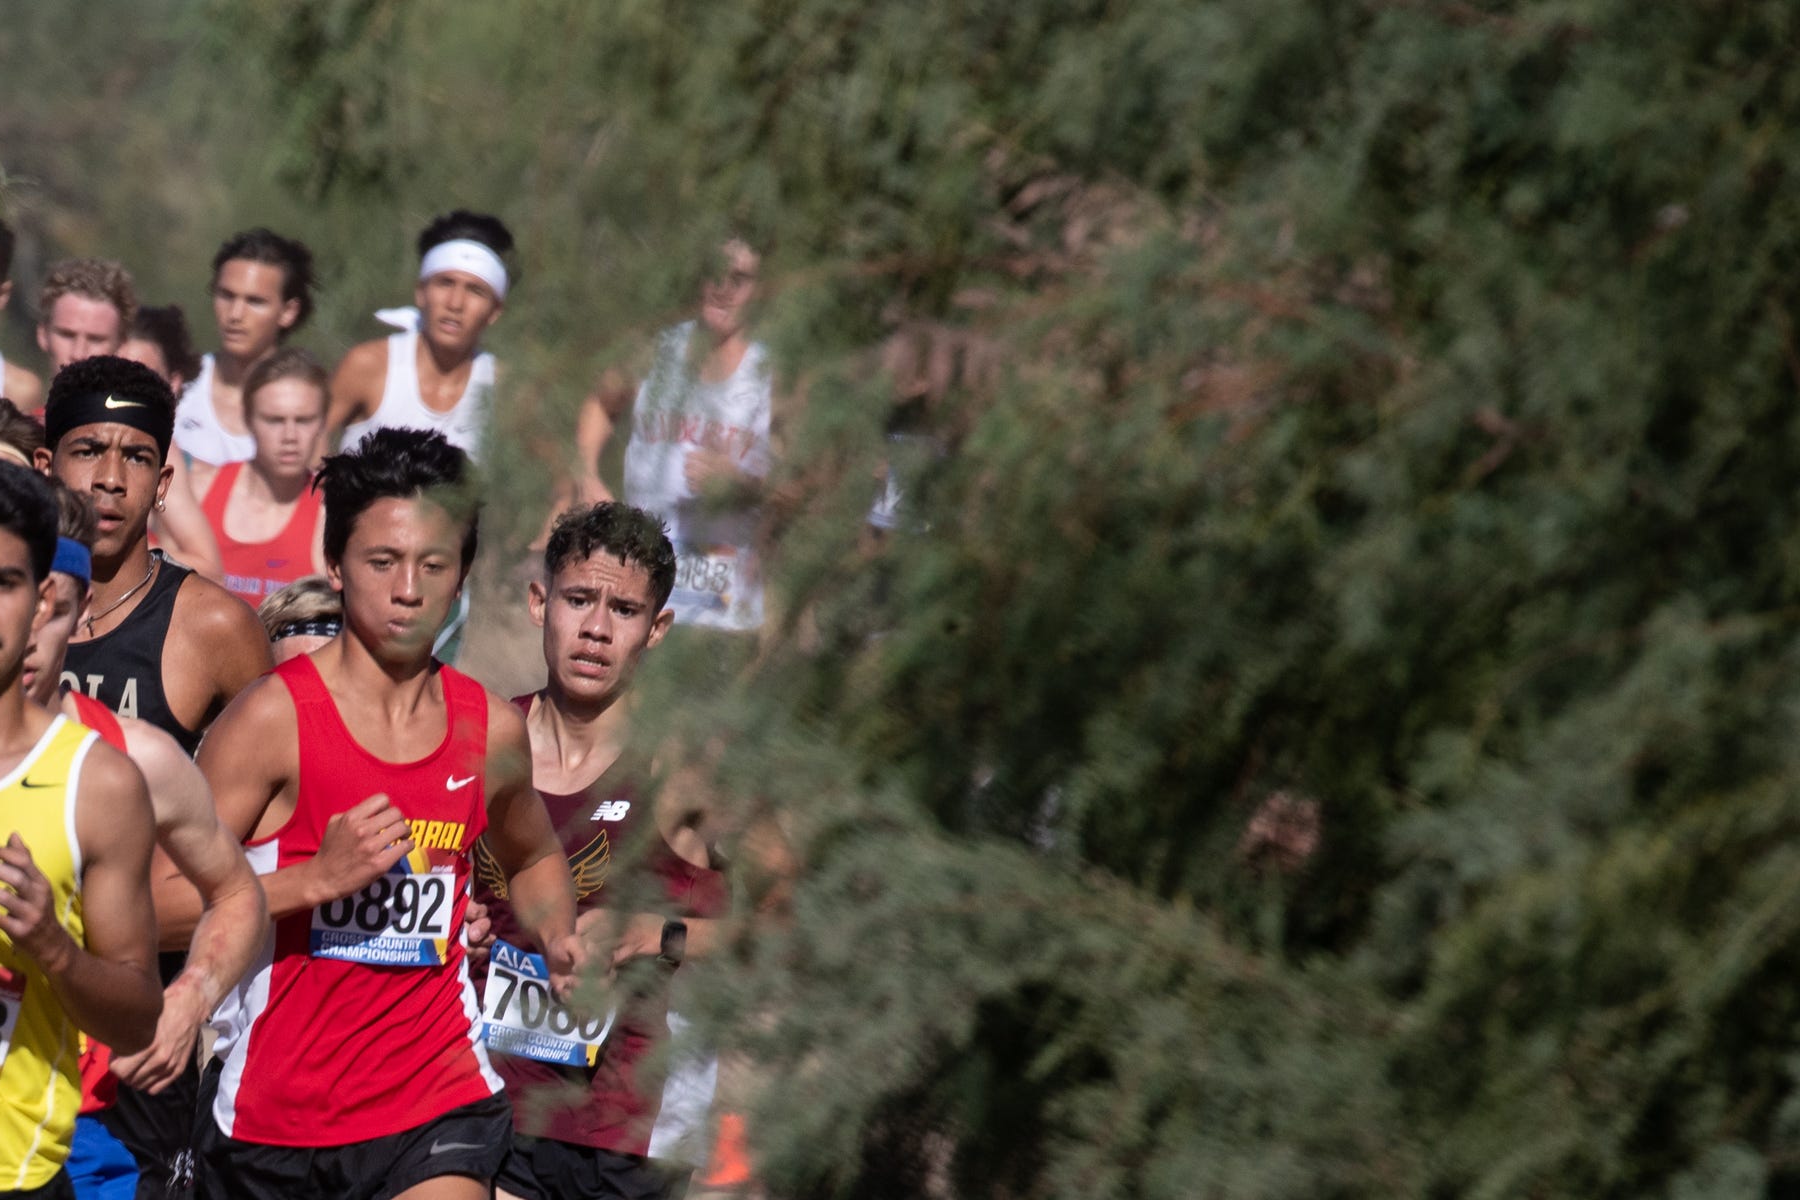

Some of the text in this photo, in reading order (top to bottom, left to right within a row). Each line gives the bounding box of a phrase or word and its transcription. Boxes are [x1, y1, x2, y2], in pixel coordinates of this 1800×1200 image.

[320, 942, 420, 962] CHAMPIONSHIPS
[368, 937, 421, 952] COUNTRY
[496, 946, 538, 976] AIA
